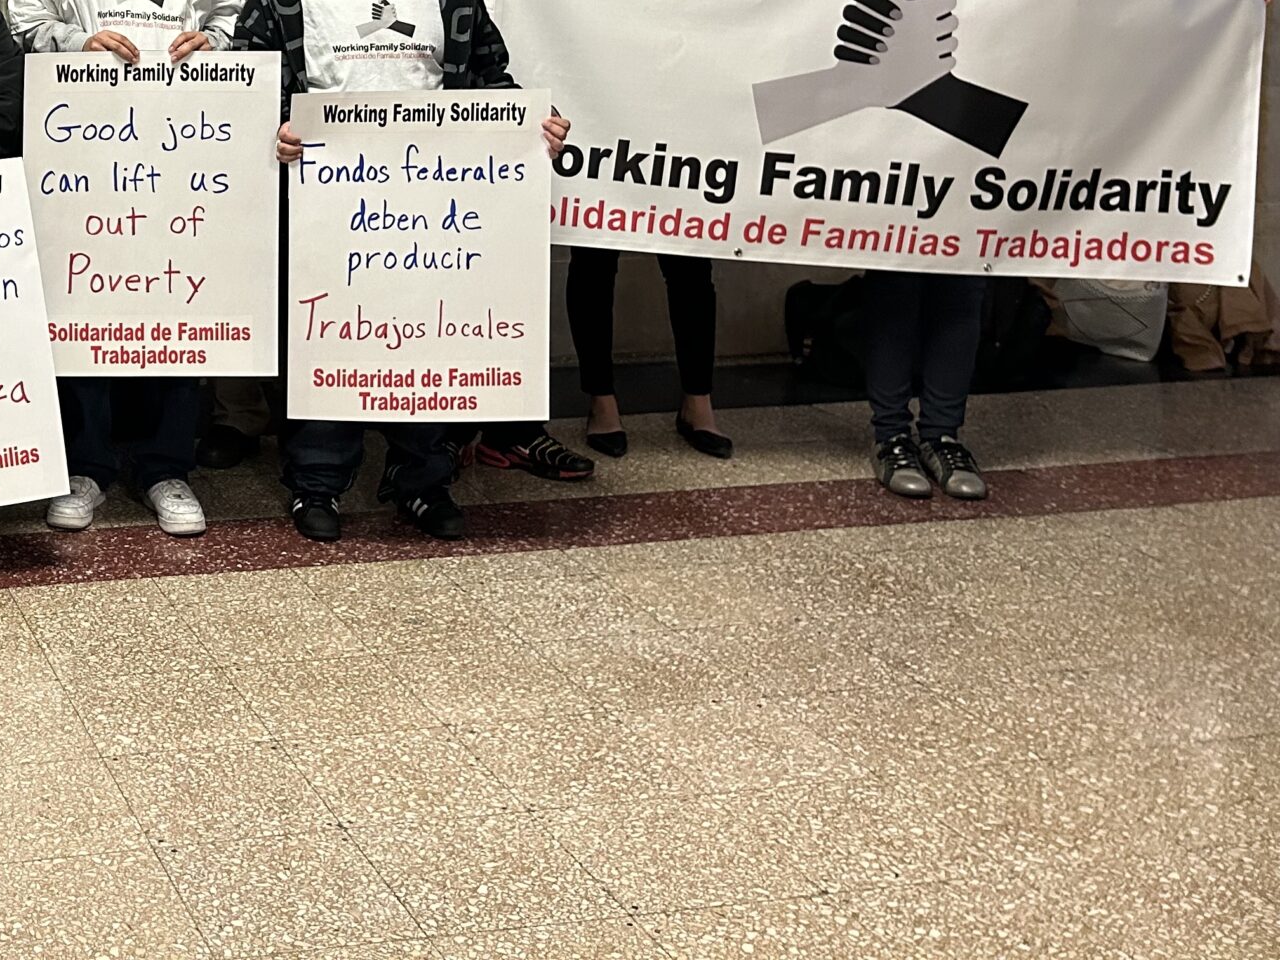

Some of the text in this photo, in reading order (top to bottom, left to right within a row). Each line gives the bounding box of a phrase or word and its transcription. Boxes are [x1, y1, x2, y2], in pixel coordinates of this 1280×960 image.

[126, 10, 151, 21] Family
[333, 43, 369, 53] Working
[369, 43, 399, 52] Family
[56, 63, 255, 86] Working Family Solidarity
[45, 104, 231, 151] Good jobs
[323, 102, 527, 127] Working Family Solidarity
[41, 162, 229, 194] can lift us
[299, 143, 525, 184] Fondos federales
[552, 138, 1232, 227] orking Family Solidarity
[86, 206, 205, 236] out of
[350, 198, 482, 233] deben de
[551, 197, 1214, 267] lidaridad de Familias Trabajadoras
[68, 253, 206, 304] Poverty
[348, 242, 481, 286] producir
[48, 322, 251, 342] Solidaridad de Familias
[299, 292, 525, 350] Trabajos locales
[91, 345, 206, 369] Trabajadoras
[313, 367, 521, 387] Solidaridad de Familias
[359, 391, 478, 415] Trabajadoras
